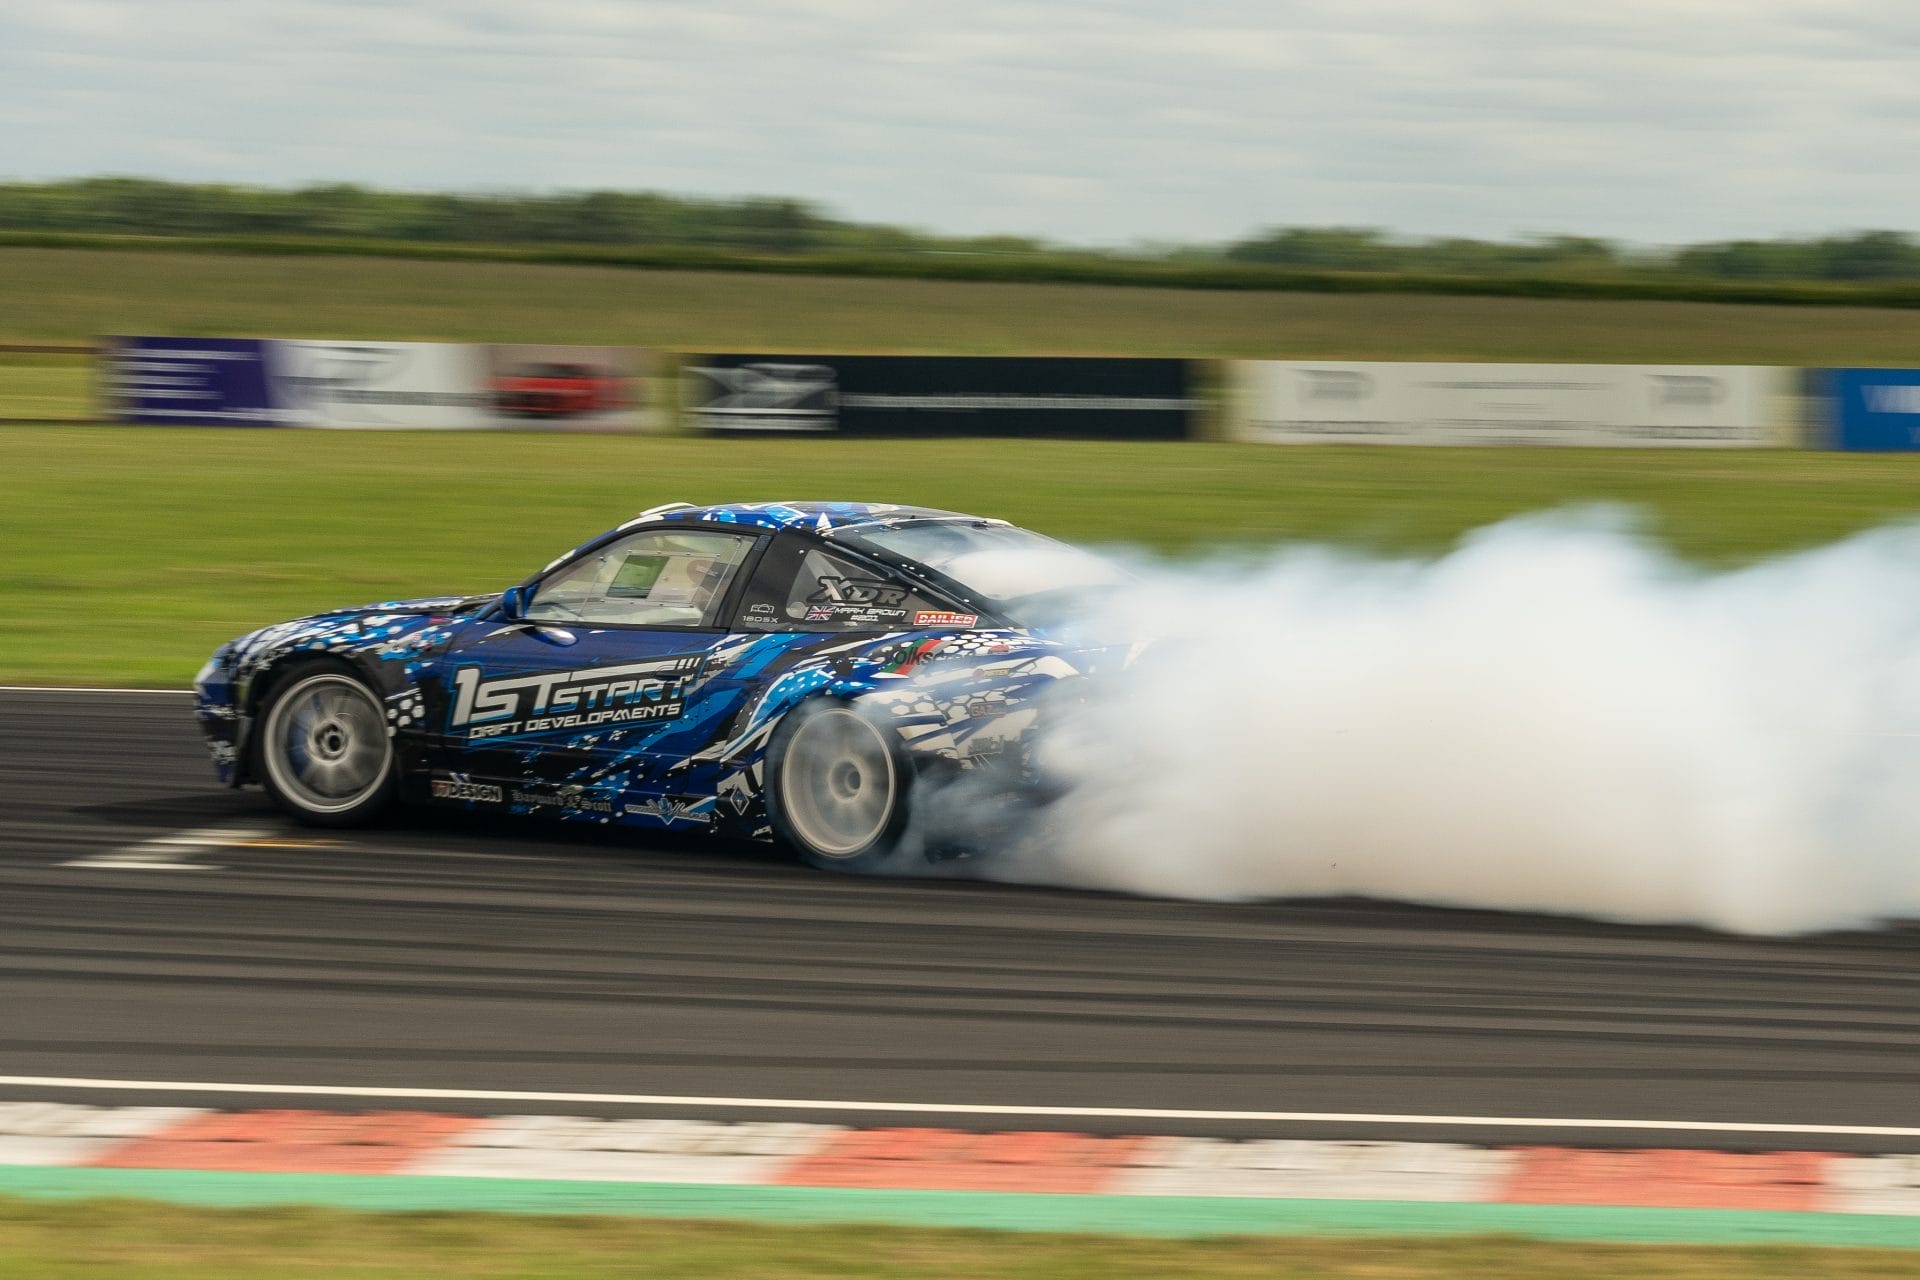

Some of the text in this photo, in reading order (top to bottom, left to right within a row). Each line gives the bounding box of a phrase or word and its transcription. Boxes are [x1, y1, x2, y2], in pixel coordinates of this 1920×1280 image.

[809, 576, 909, 606] XDR
[834, 607, 907, 617] MARK BROWN
[918, 614, 973, 624] DAILIED
[548, 674, 695, 713] START
[468, 702, 682, 740] DRIFT DEVELOPMENTS
